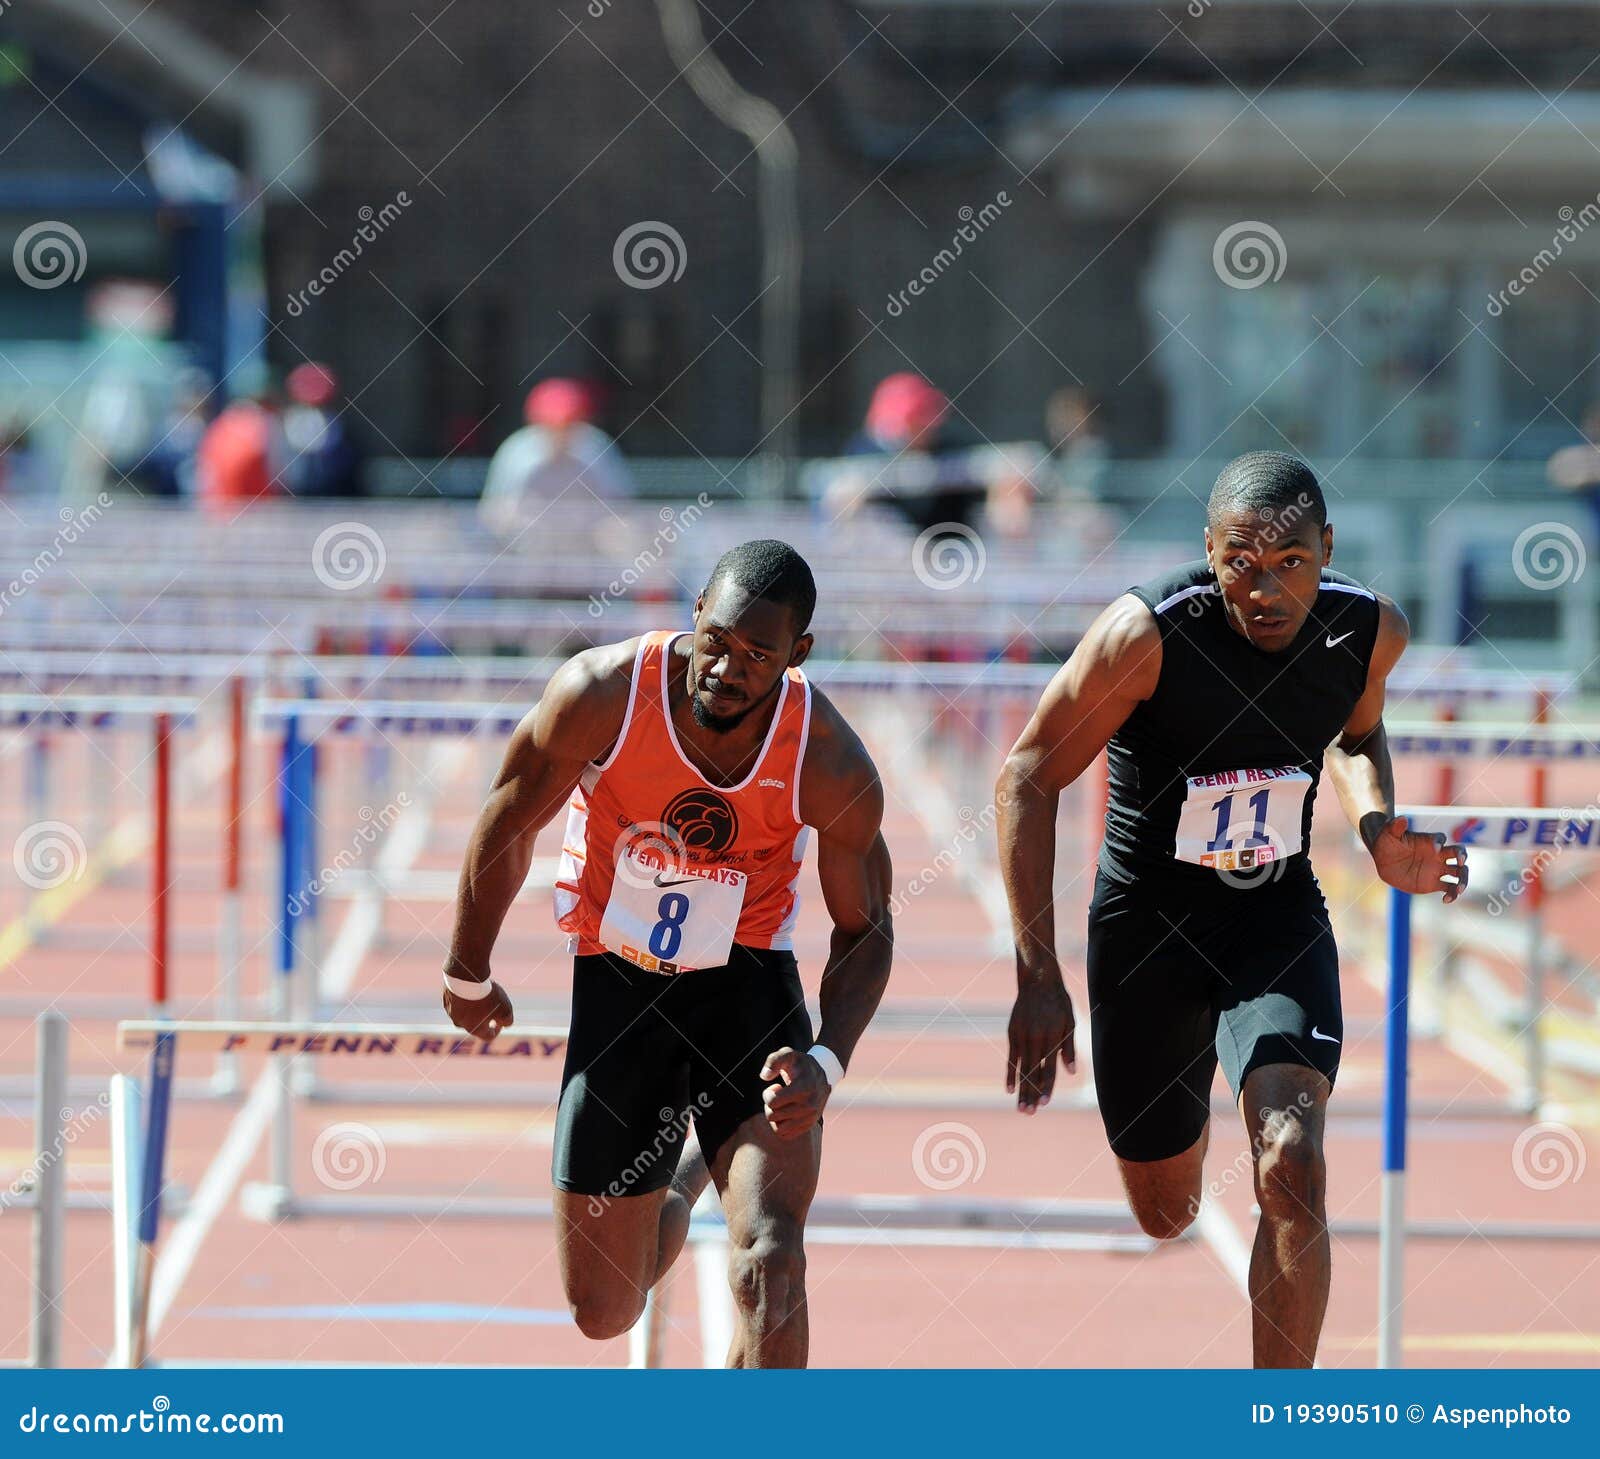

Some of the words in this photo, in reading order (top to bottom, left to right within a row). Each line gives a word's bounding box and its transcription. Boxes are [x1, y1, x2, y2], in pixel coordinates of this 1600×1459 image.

[1193, 770, 1239, 787] PENN
[1246, 766, 1299, 782] RELAYS
[1207, 789, 1271, 852] 11
[1503, 818, 1600, 846] PEN
[648, 893, 689, 959] 8
[269, 1034, 395, 1054] PENN
[414, 1035, 563, 1058] RELAY
